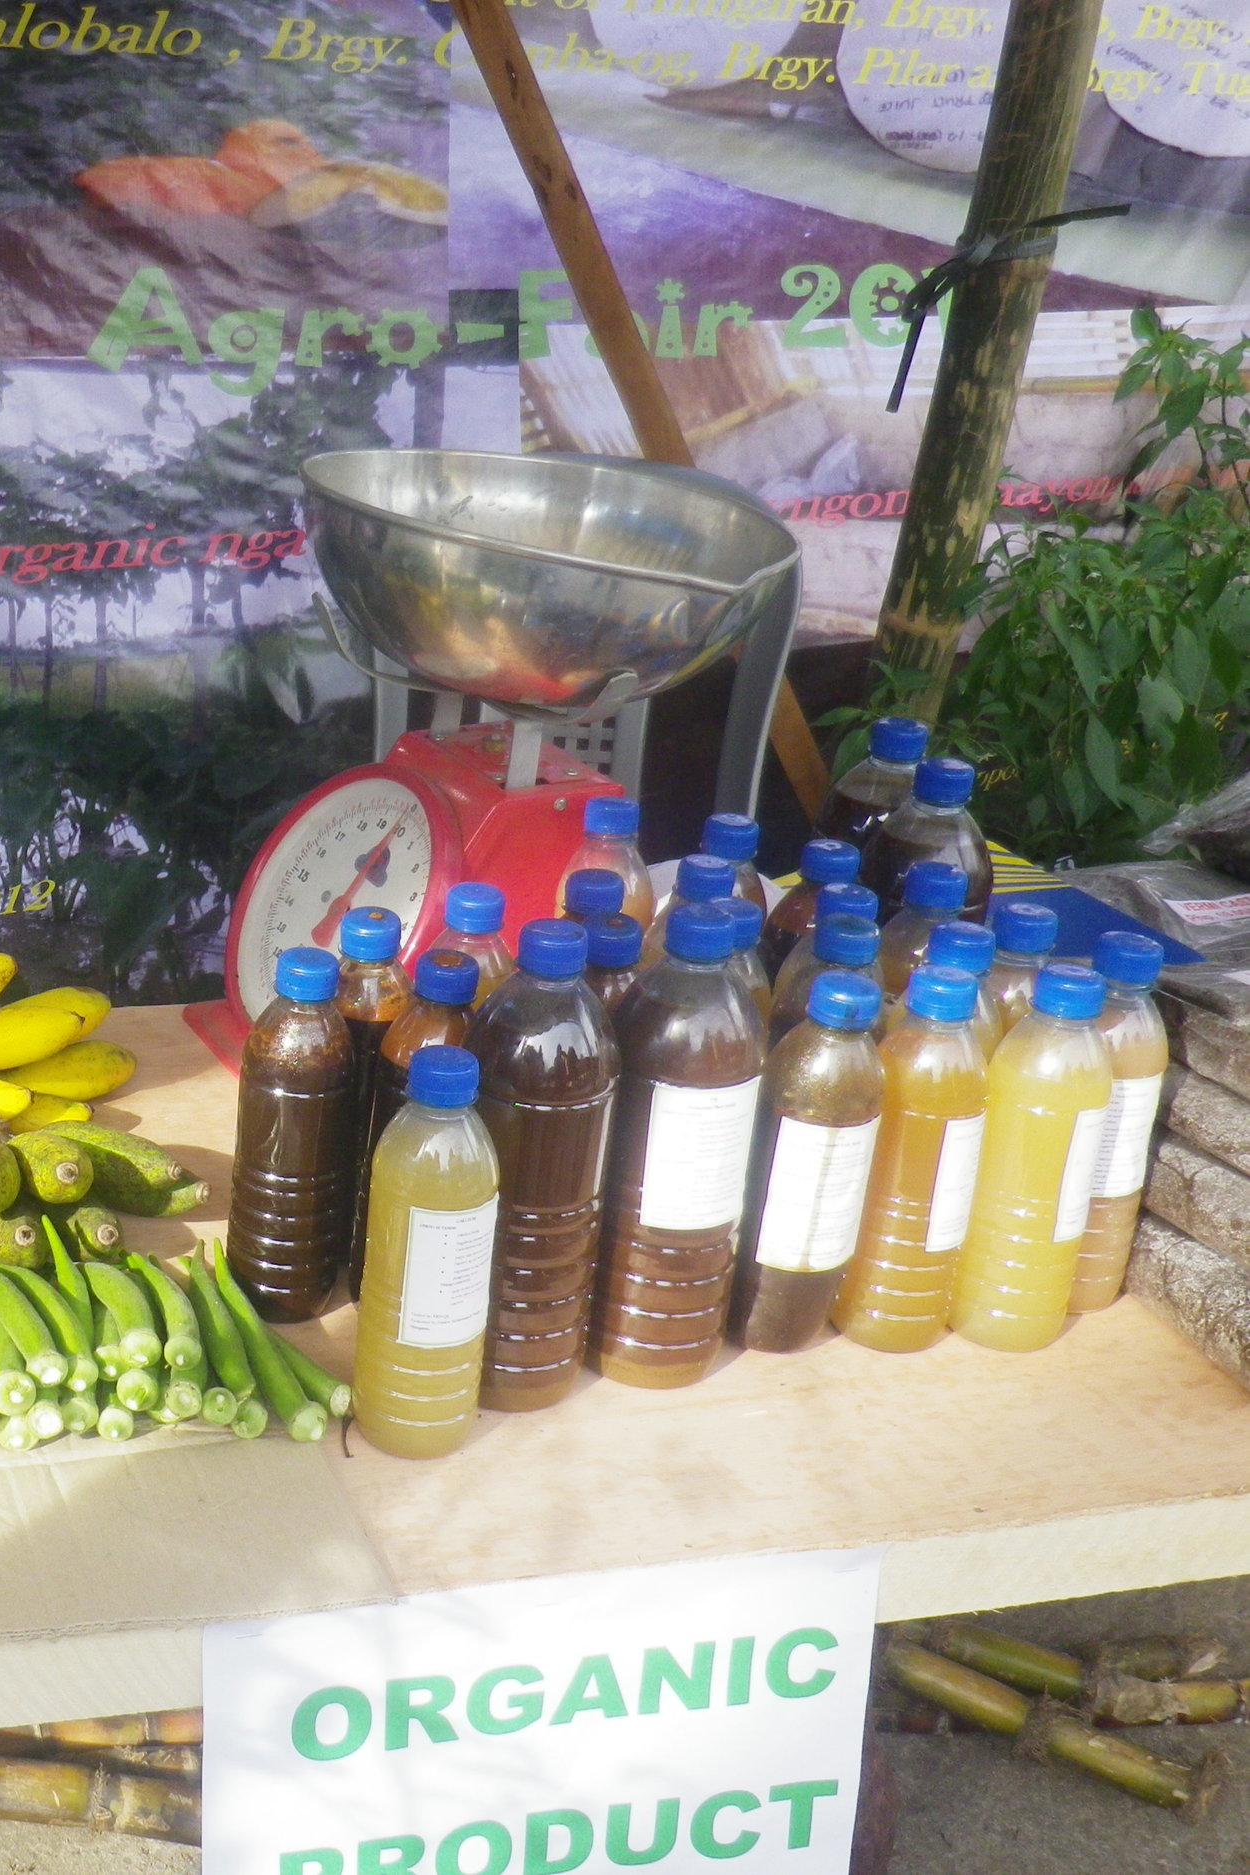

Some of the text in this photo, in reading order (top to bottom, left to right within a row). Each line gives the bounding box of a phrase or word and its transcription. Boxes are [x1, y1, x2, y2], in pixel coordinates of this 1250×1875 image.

[262, 17, 407, 73] Brgy.
[716, 41, 835, 91] Brgy.
[853, 47, 950, 87] Pilar
[1130, 5, 1231, 51] Brgy.
[198, 526, 308, 571] nga
[291, 1626, 839, 1762] ORGANIC
